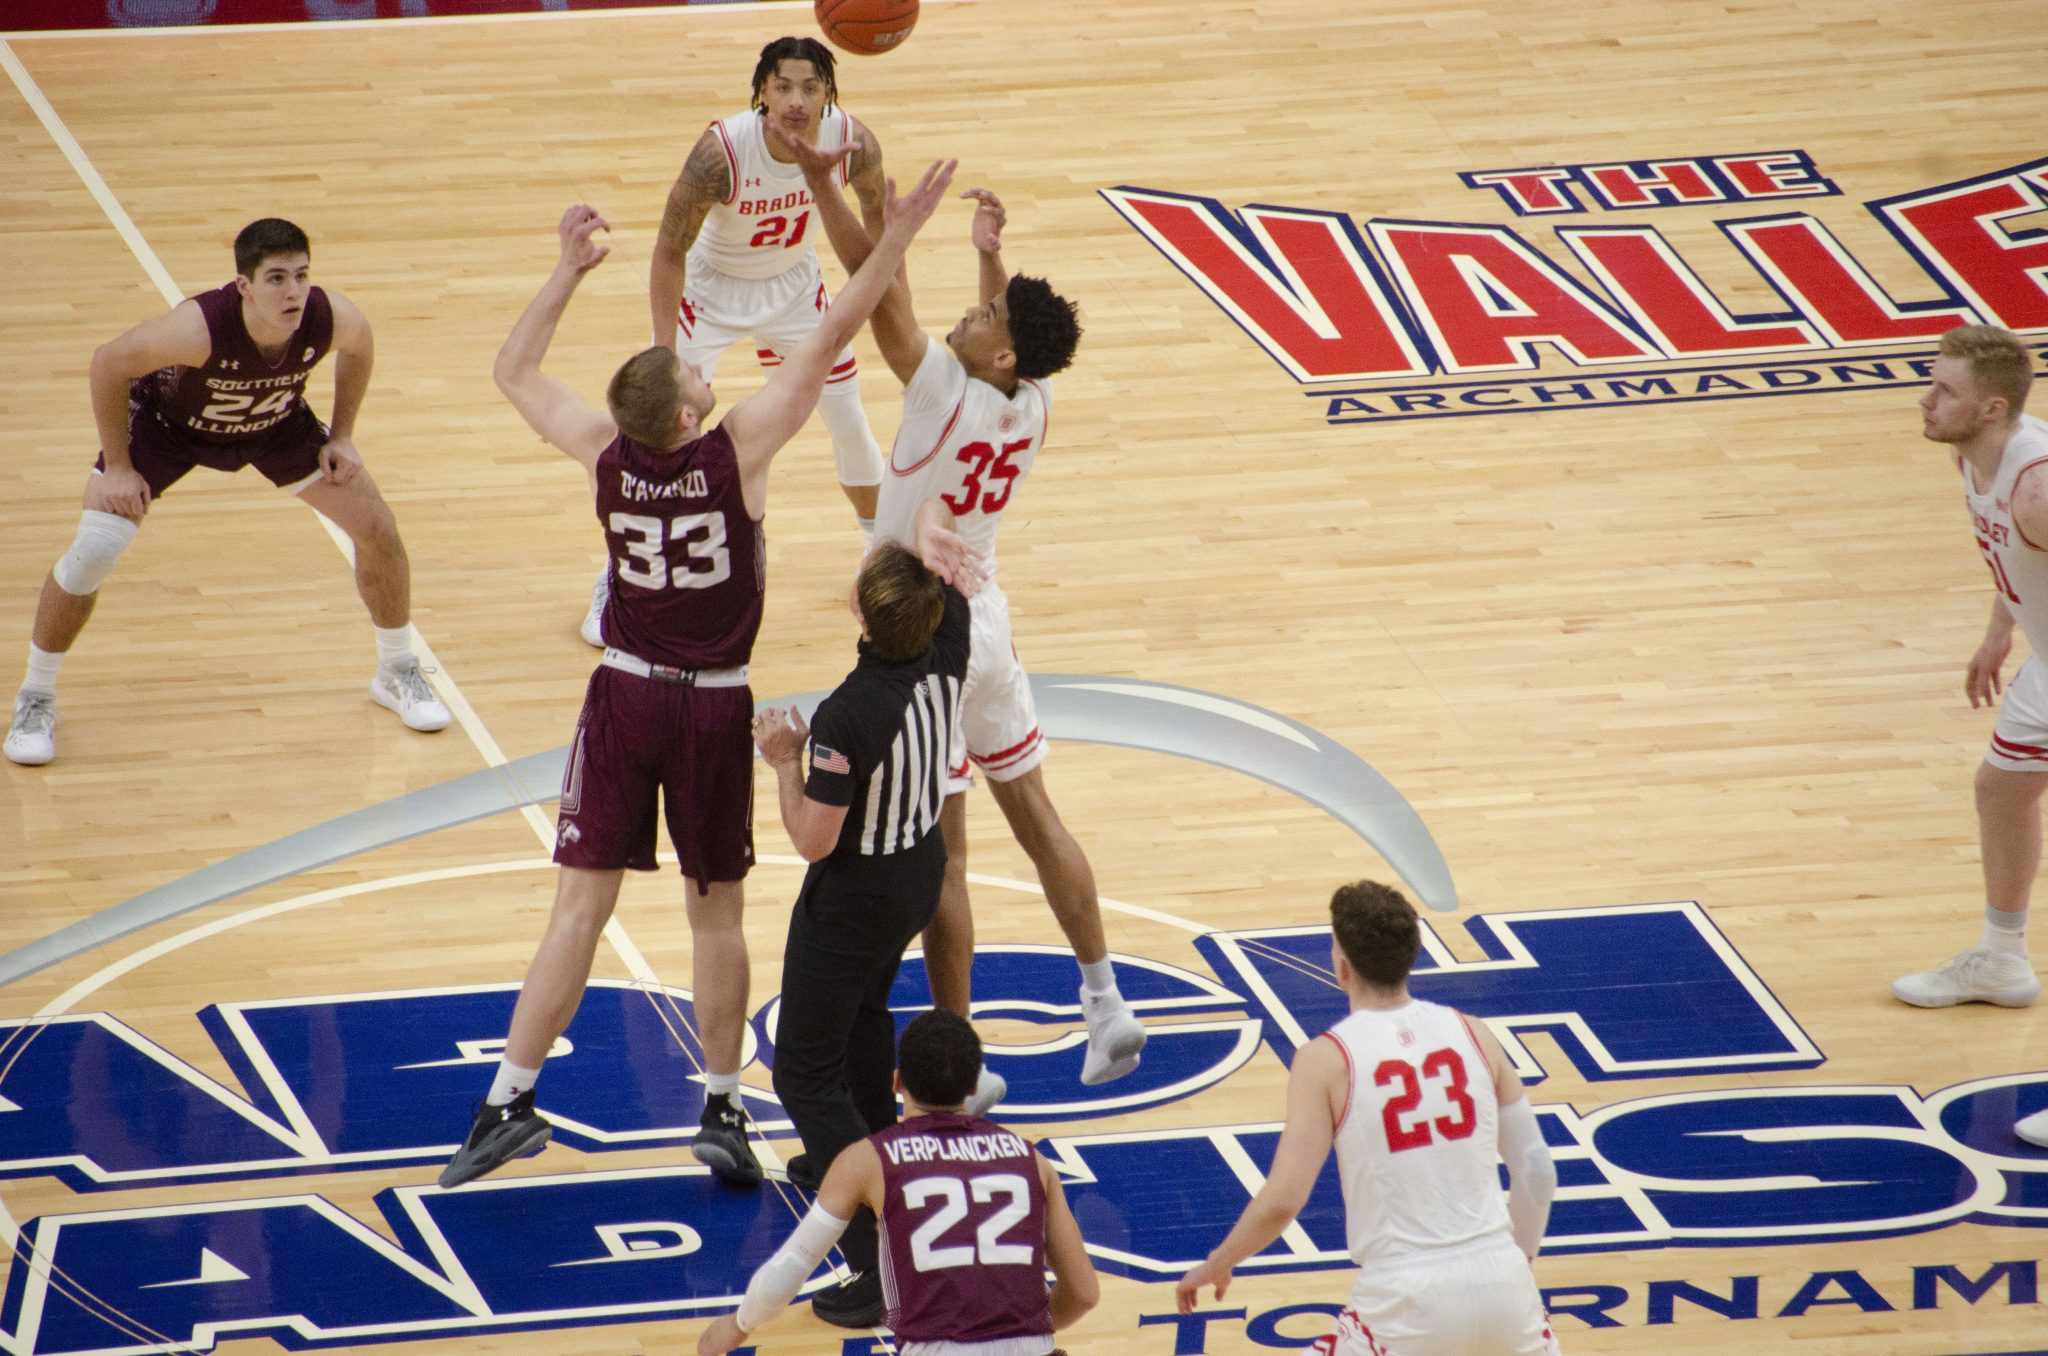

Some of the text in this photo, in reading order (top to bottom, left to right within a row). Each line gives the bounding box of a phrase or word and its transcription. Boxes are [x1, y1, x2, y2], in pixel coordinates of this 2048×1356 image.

[739, 190, 815, 215] BRADL
[1458, 149, 1844, 216] THE
[749, 210, 811, 248] 21
[1099, 157, 2048, 384] VALLE
[201, 389, 296, 423] 24
[1326, 352, 2048, 417] ARCHMADNE
[620, 469, 709, 502] D'AVANZO
[940, 437, 1034, 516] 35
[609, 511, 731, 591] 33
[1373, 1047, 1477, 1153] 23
[884, 1133, 1030, 1165] VERPLANCKEN
[902, 1174, 1034, 1273] 22
[1138, 1260, 2042, 1356] TORNAM
